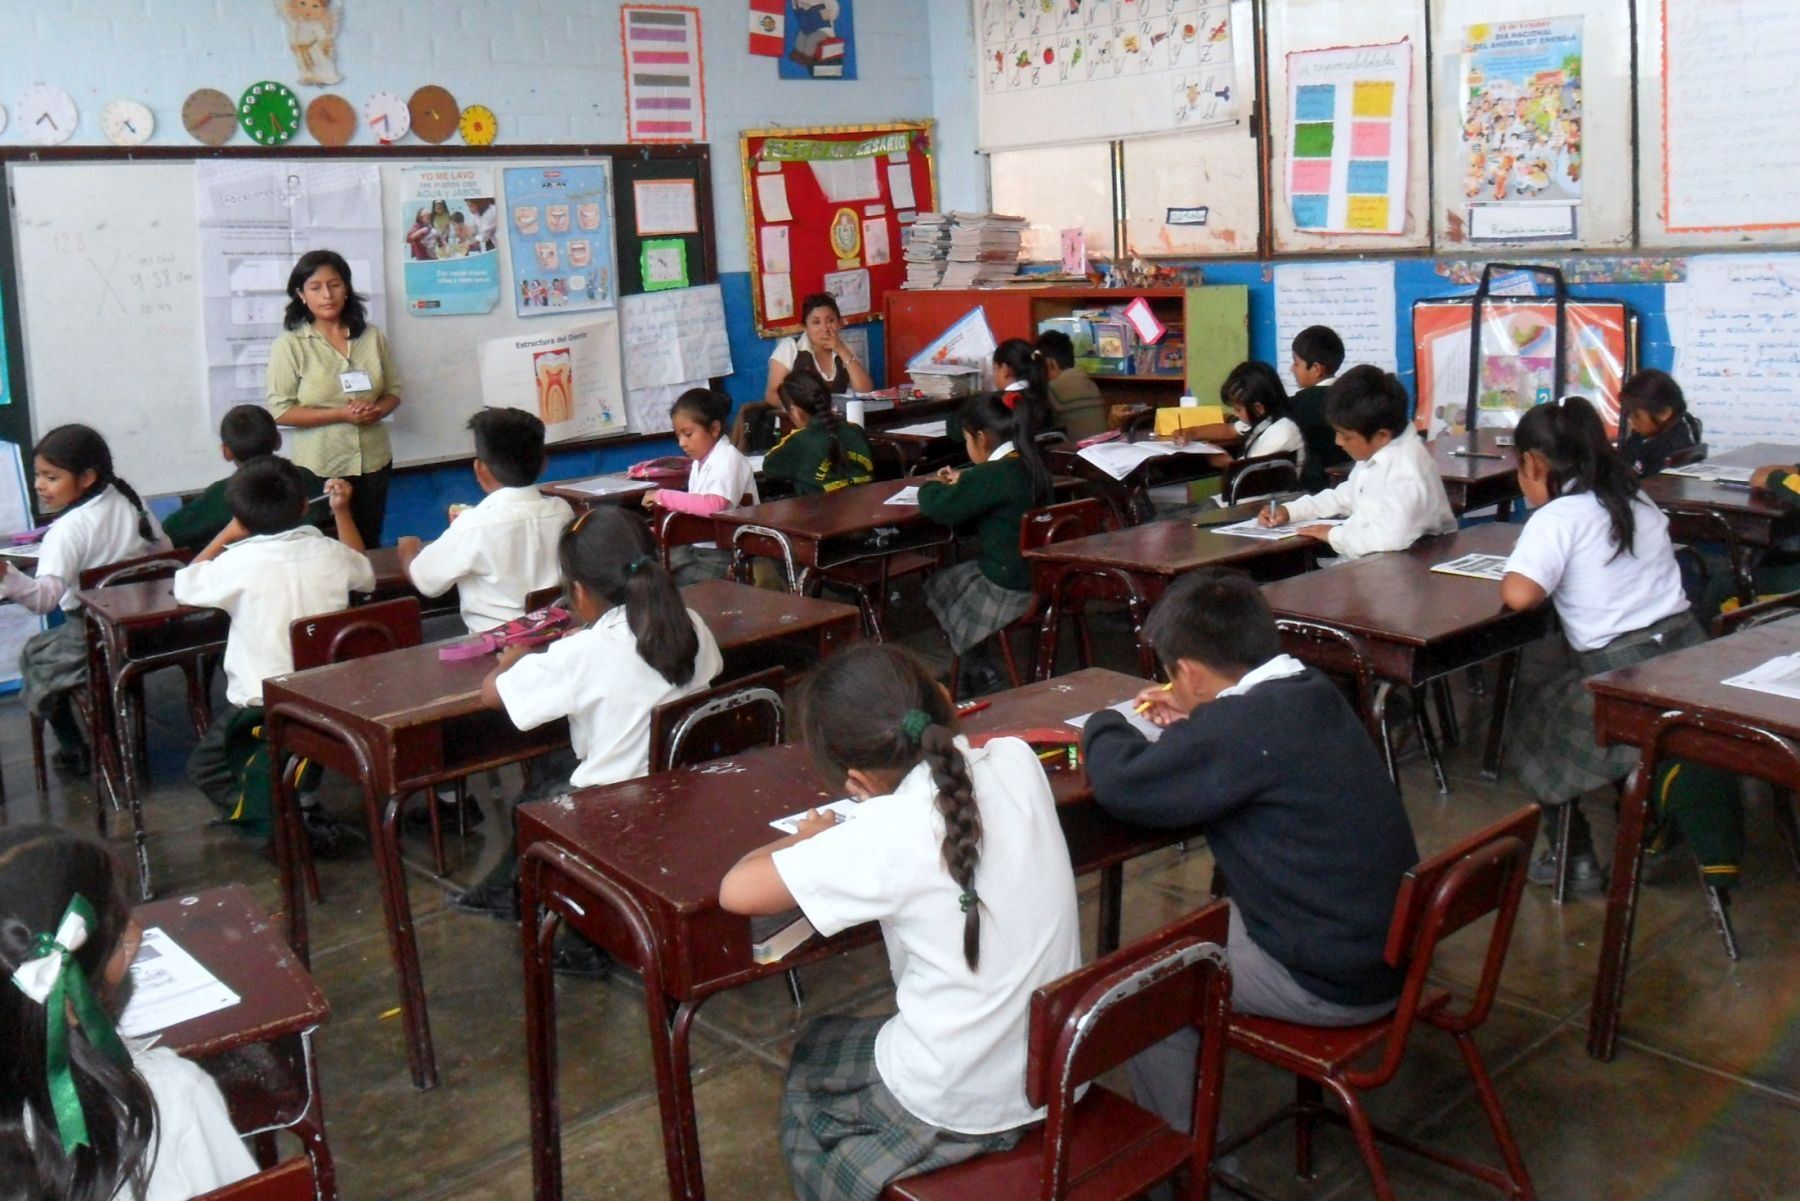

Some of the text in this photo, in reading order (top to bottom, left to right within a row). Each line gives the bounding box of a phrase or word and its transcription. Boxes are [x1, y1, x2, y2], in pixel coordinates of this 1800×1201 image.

[1511, 29, 1552, 38] NACIONAL
[1491, 39, 1525, 49] AHORRO
[421, 171, 474, 180] YO ME LAVO
[416, 189, 443, 198] AGUA
[515, 338, 555, 349] Estructura
[557, 336, 567, 344] del
